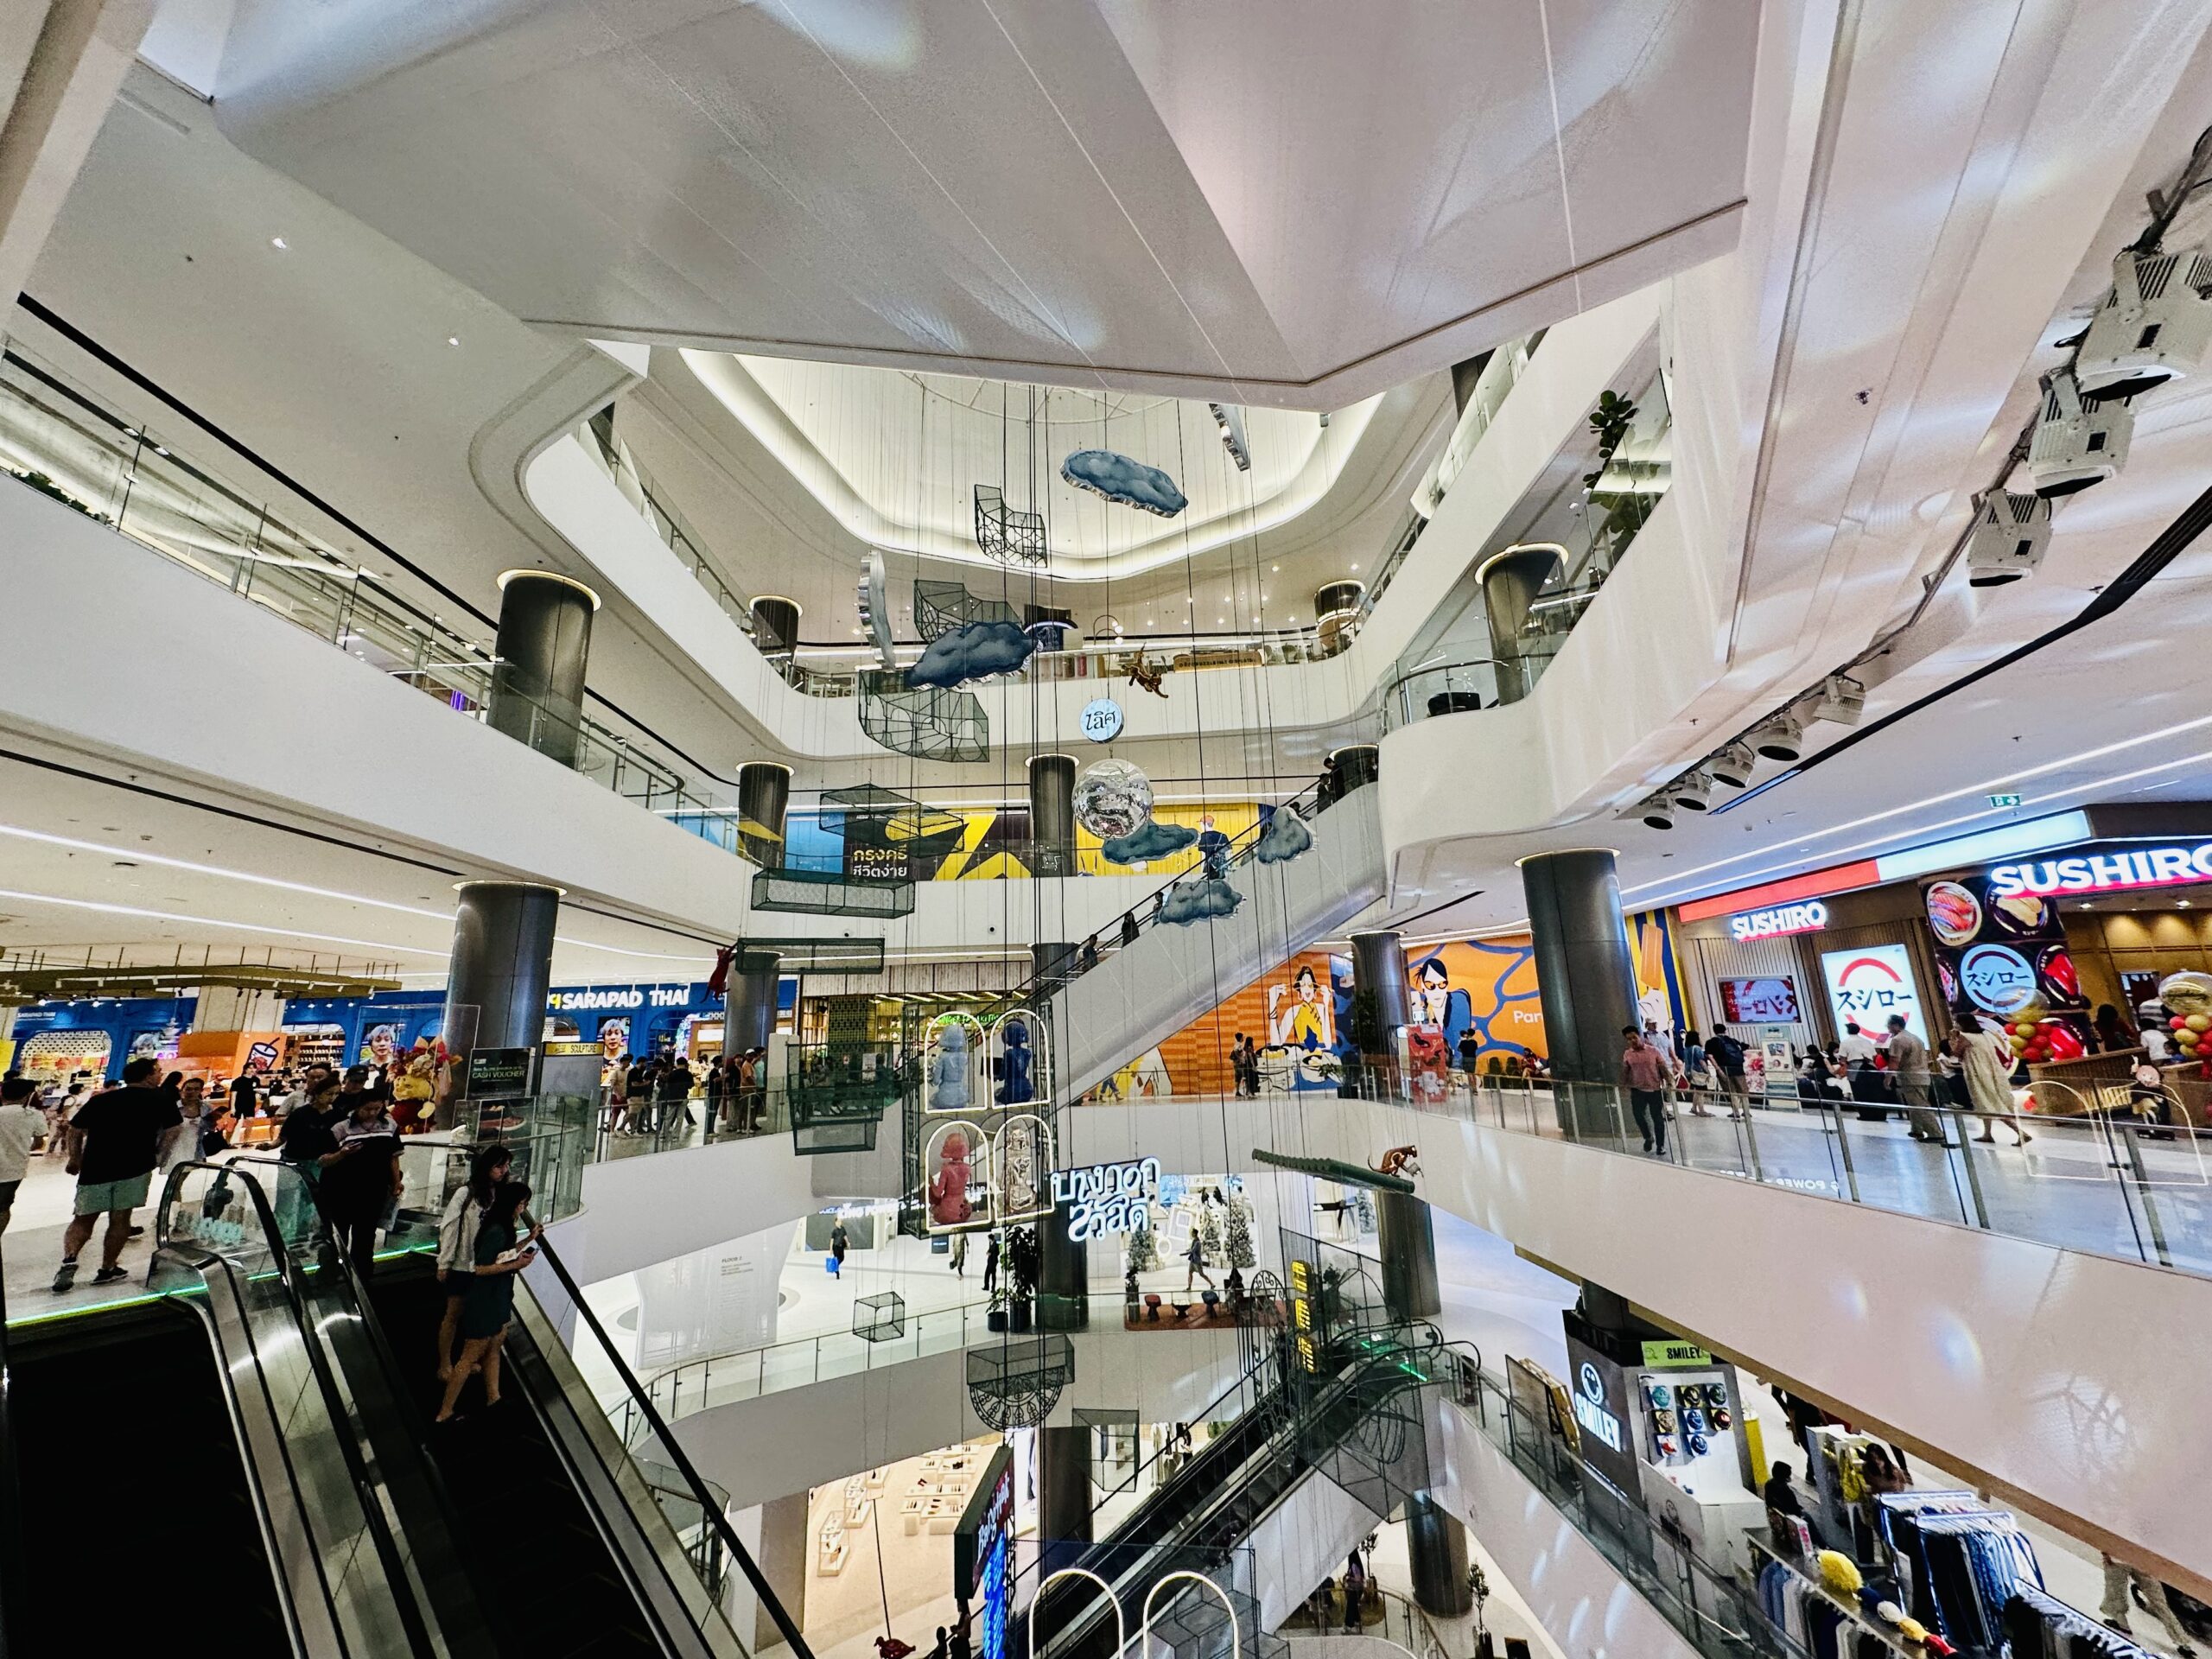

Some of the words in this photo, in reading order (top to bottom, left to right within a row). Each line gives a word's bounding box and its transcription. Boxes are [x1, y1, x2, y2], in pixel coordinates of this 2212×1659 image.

[853, 864, 907, 878] ชีวิตง่าย
[1732, 901, 1827, 940] SUSHIRO
[1966, 970, 2031, 988] スシロー
[563, 990, 644, 1009] SARAPAD
[649, 988, 690, 1007] THAI
[1836, 988, 1913, 1011] スシロー
[493, 1070, 525, 1078] VOUCHER
[1050, 1157, 1160, 1203] บางกอก
[1068, 1189, 1148, 1242] สวัสดี
[1667, 1346, 1701, 1360] SMILEY
[1574, 1391, 1621, 1452] SMILEY
